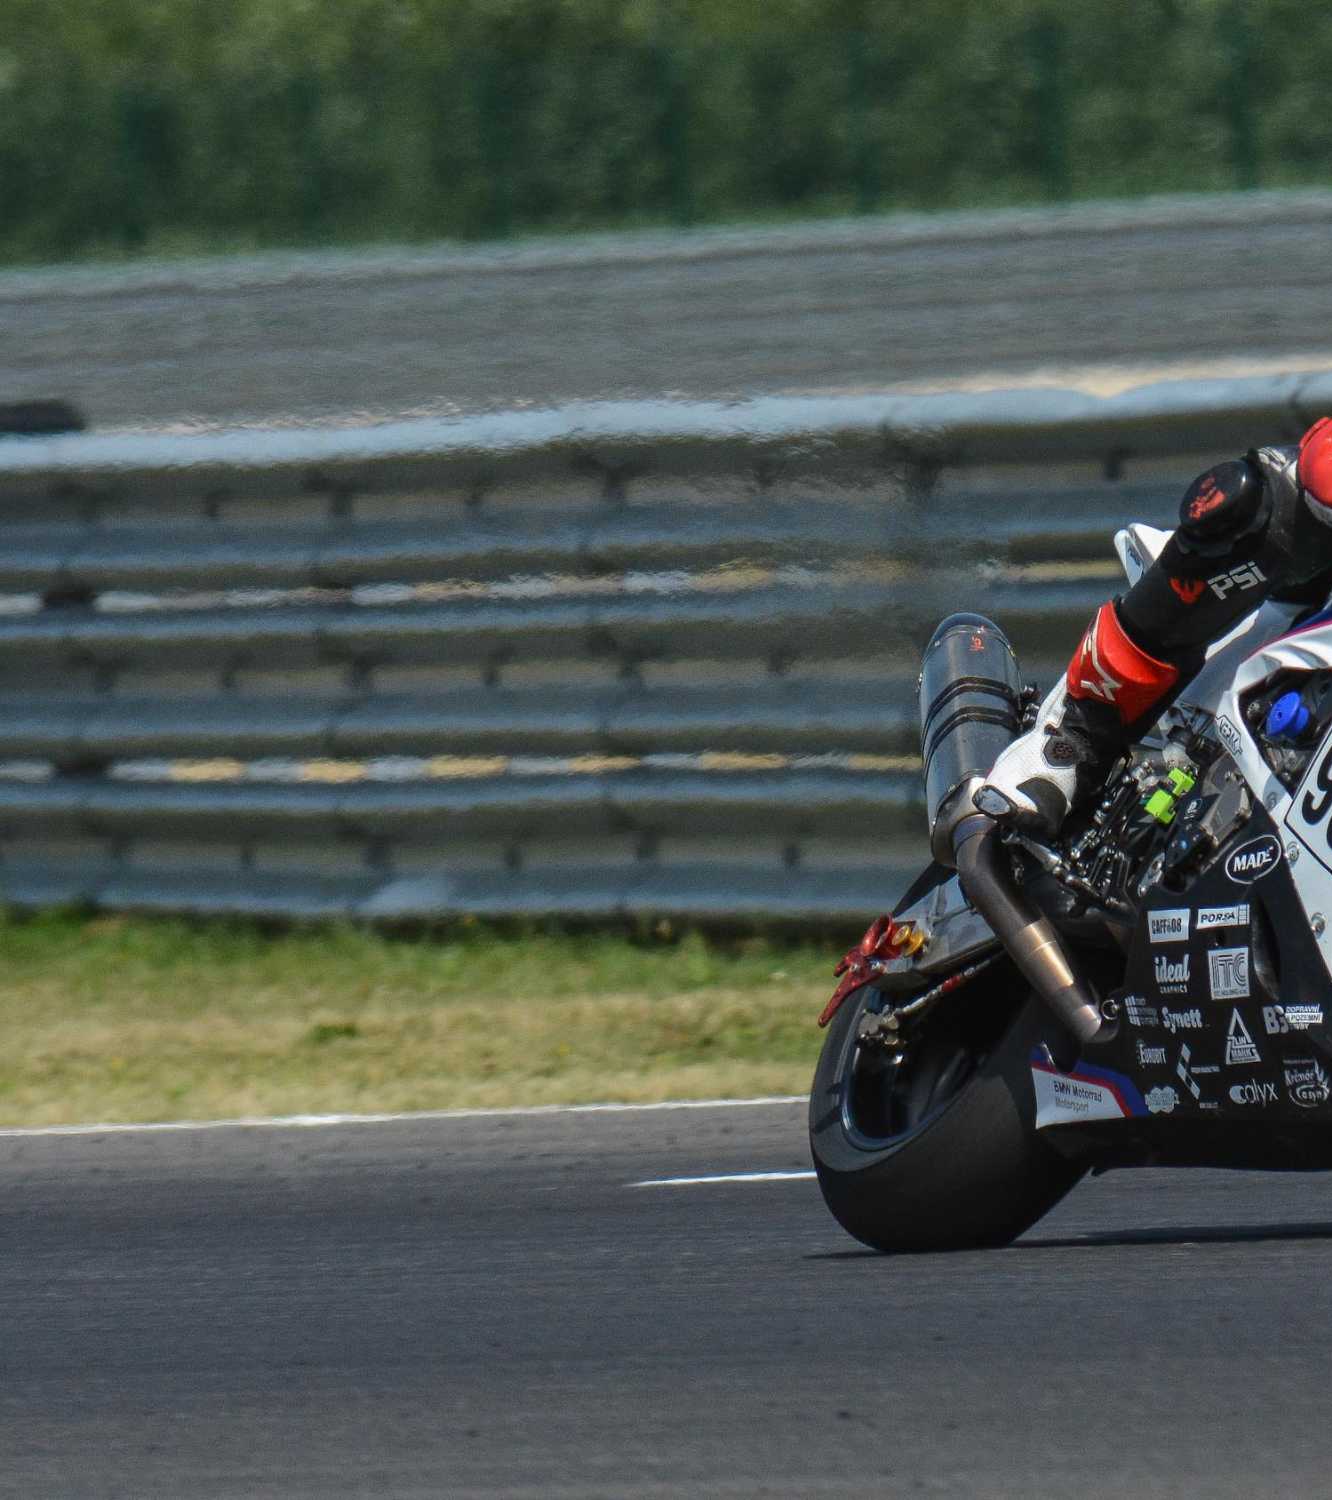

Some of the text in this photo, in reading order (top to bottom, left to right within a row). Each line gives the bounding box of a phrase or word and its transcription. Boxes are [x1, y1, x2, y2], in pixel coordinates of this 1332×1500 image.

[1154, 953, 1191, 984] ideal
[1211, 952, 1248, 990] ITC
[1161, 1006, 1203, 1034] Synett
[1072, 1084, 1103, 1104] Motorrad
